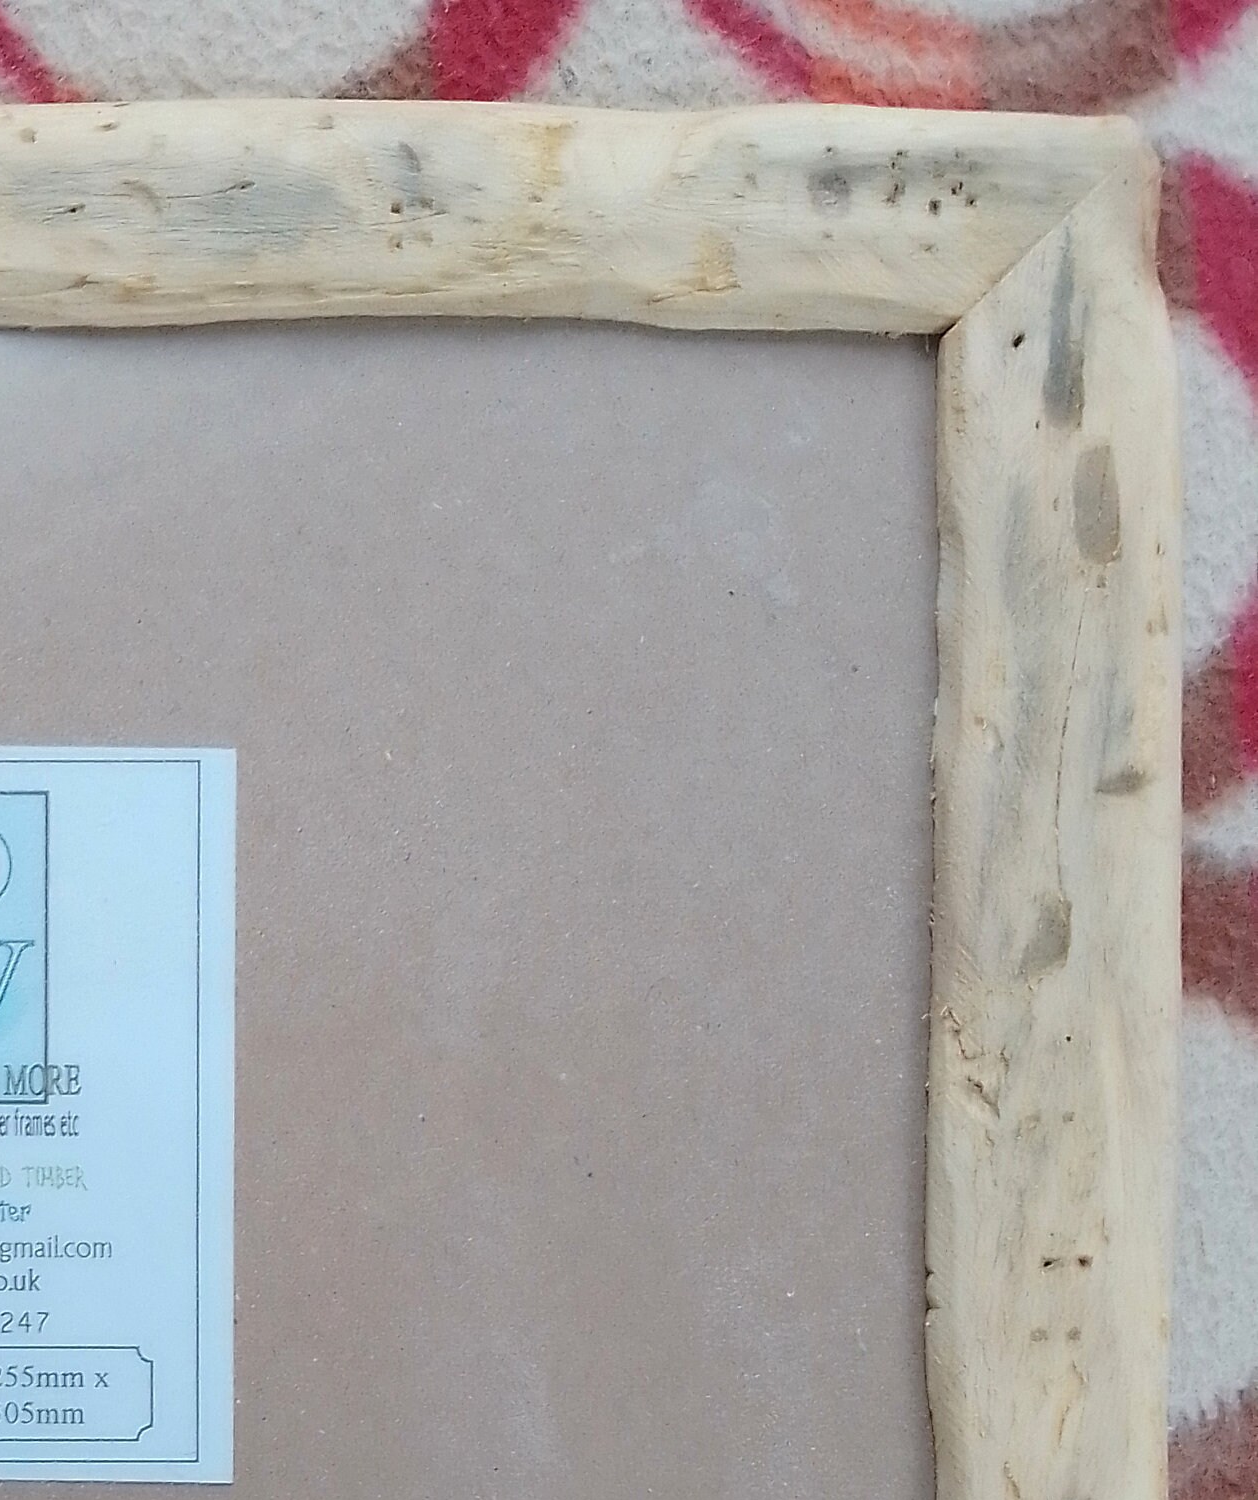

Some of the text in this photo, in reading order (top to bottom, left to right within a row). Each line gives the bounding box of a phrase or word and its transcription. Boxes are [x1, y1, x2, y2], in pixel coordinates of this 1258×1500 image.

[3, 1064, 82, 1096] MORE
[14, 1110, 56, 1137] frames
[60, 1110, 80, 1137] etc
[21, 1165, 88, 1190] TIMBER
[94, 1372, 110, 1388] x
